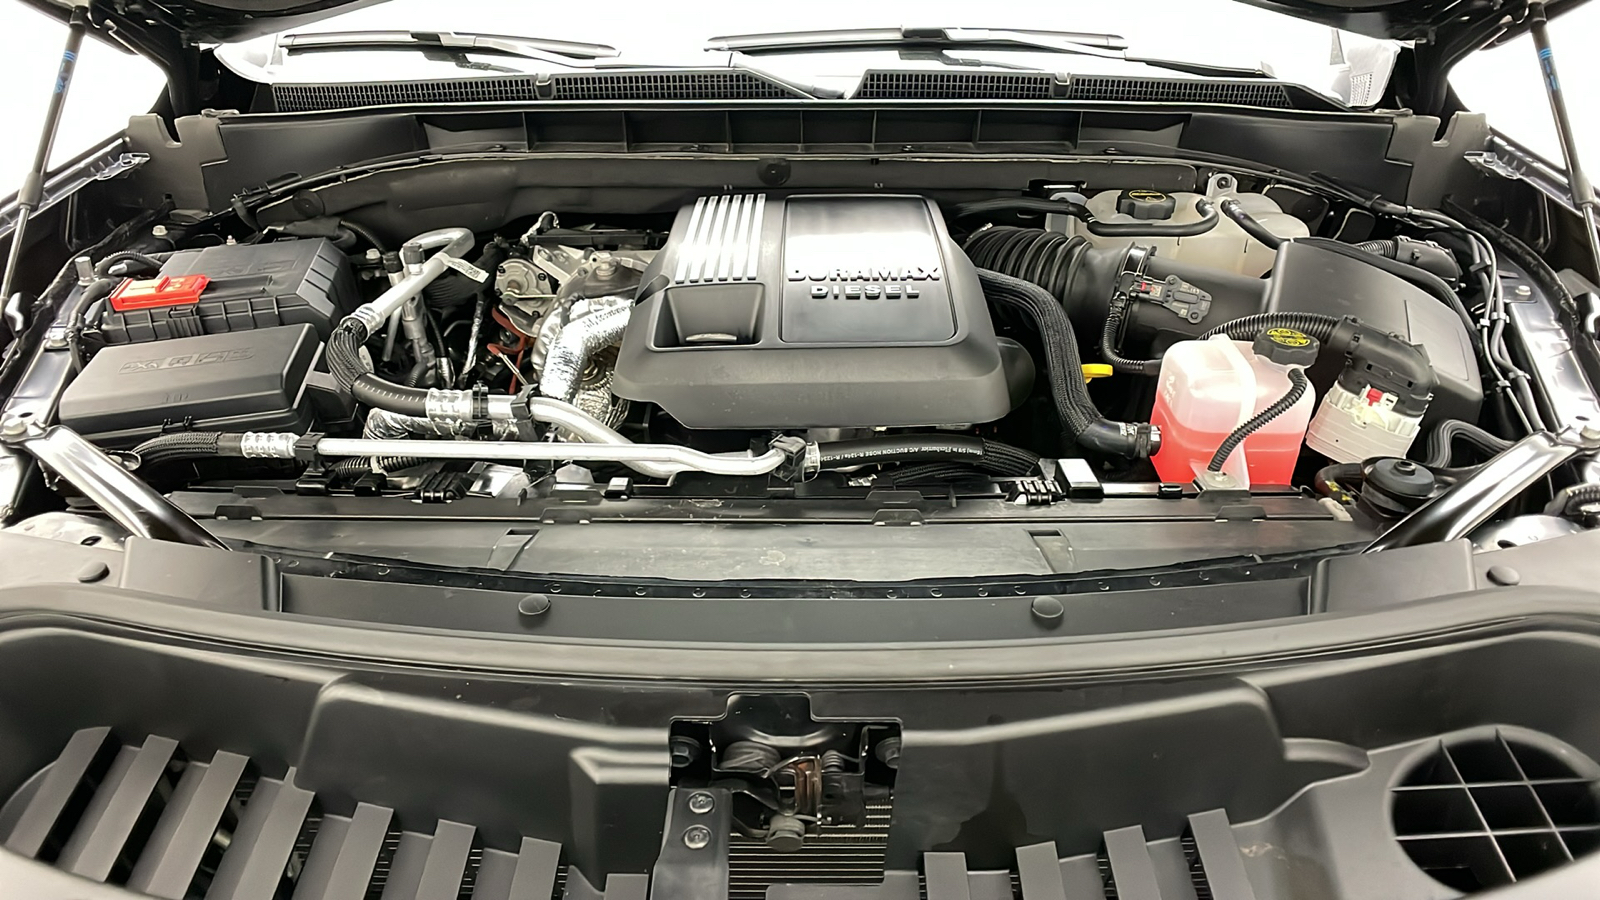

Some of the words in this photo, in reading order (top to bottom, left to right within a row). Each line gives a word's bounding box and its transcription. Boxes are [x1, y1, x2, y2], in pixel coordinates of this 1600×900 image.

[787, 266, 940, 281] DURAMAX
[811, 284, 920, 299] DIESEL
[882, 447, 908, 455] SUCTION
